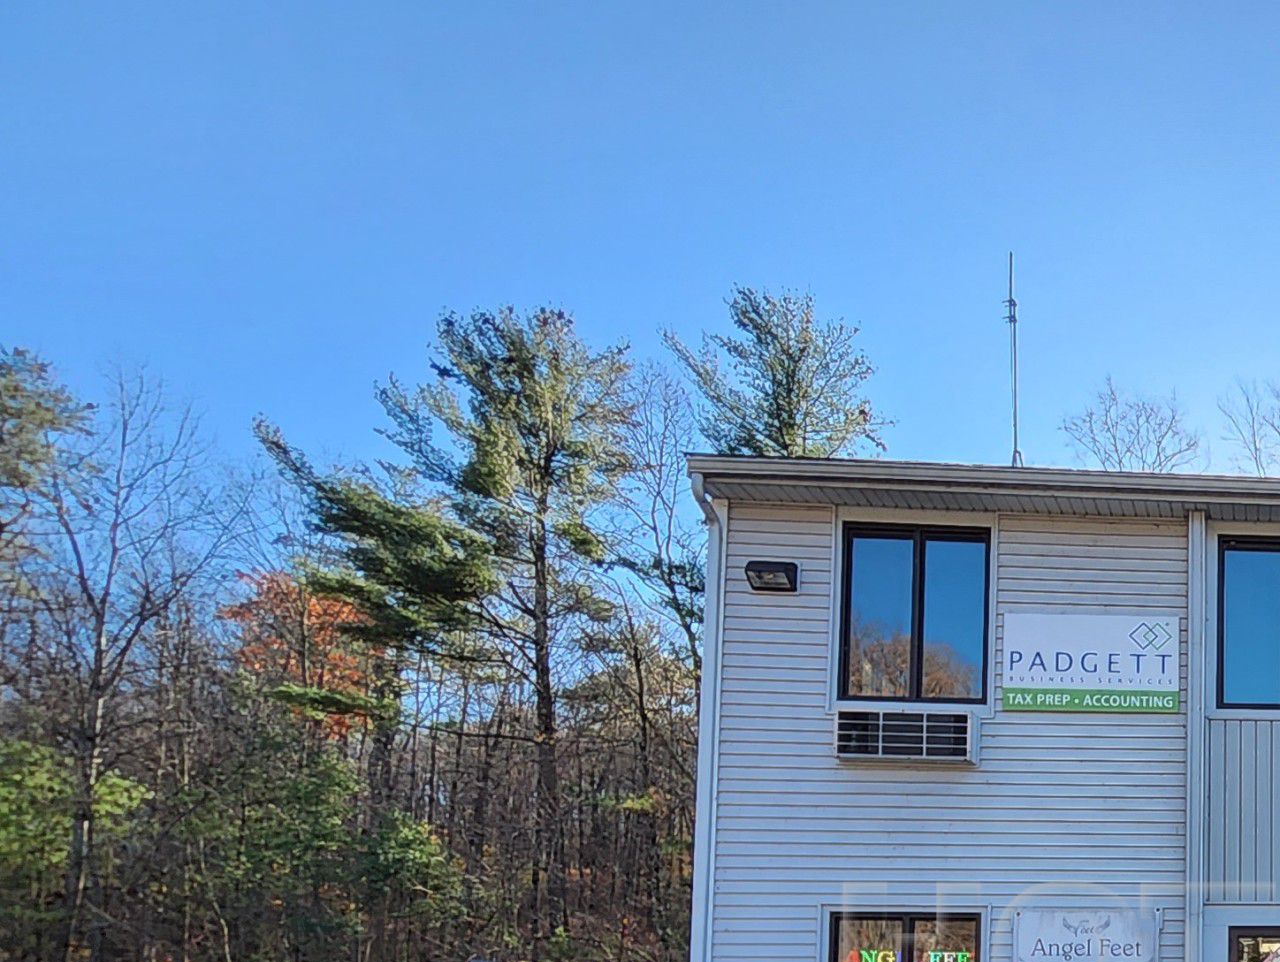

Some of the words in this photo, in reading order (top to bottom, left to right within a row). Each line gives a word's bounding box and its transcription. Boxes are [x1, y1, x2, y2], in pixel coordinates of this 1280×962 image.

[1009, 651, 1172, 675] PADGETT
[1098, 677, 1172, 685] SERVICES
[1007, 693, 1033, 705] TAX
[1036, 694, 1071, 706] PREP
[1082, 695, 1173, 708] ACCOUNTING
[1031, 938, 1092, 961] Angel
[1099, 939, 1142, 957] Feet
